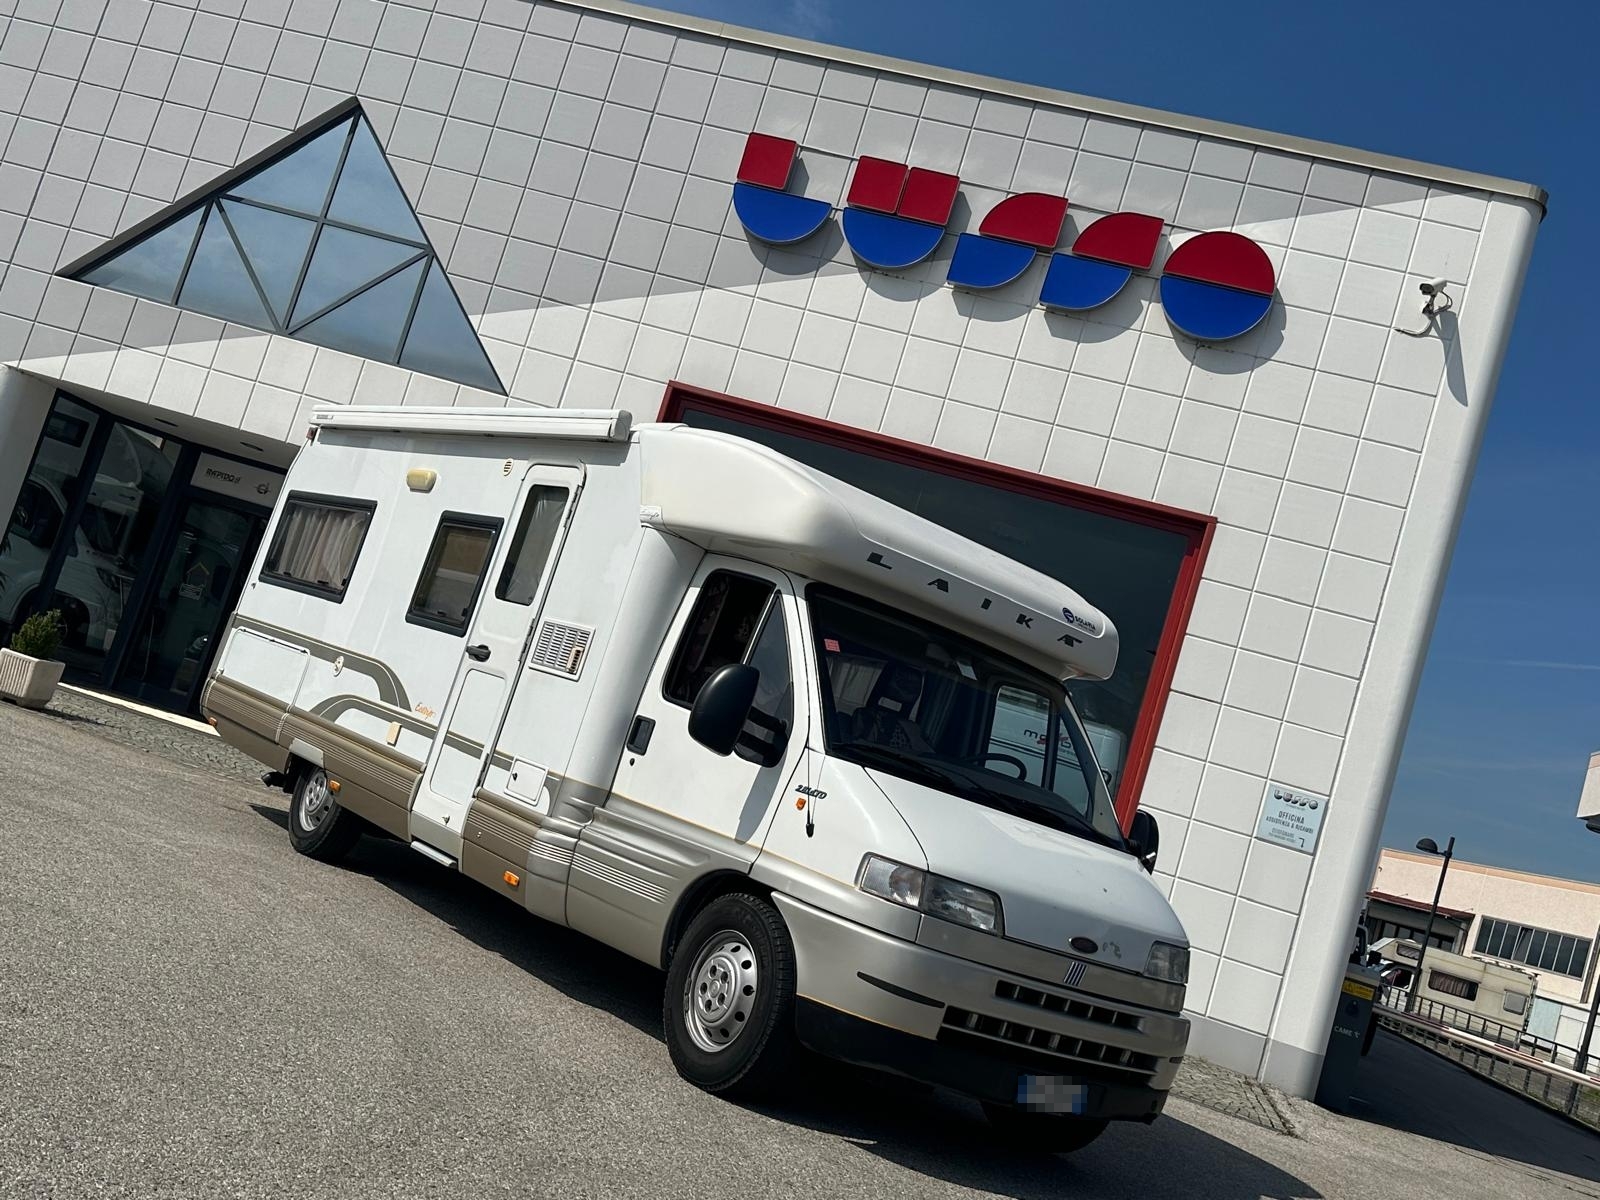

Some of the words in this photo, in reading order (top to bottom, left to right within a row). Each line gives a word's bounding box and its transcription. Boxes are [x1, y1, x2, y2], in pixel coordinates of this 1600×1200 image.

[866, 552, 1083, 648] LAIKA
[1278, 810, 1305, 824] OFFICINA
[1334, 1026, 1354, 1038] CAME
